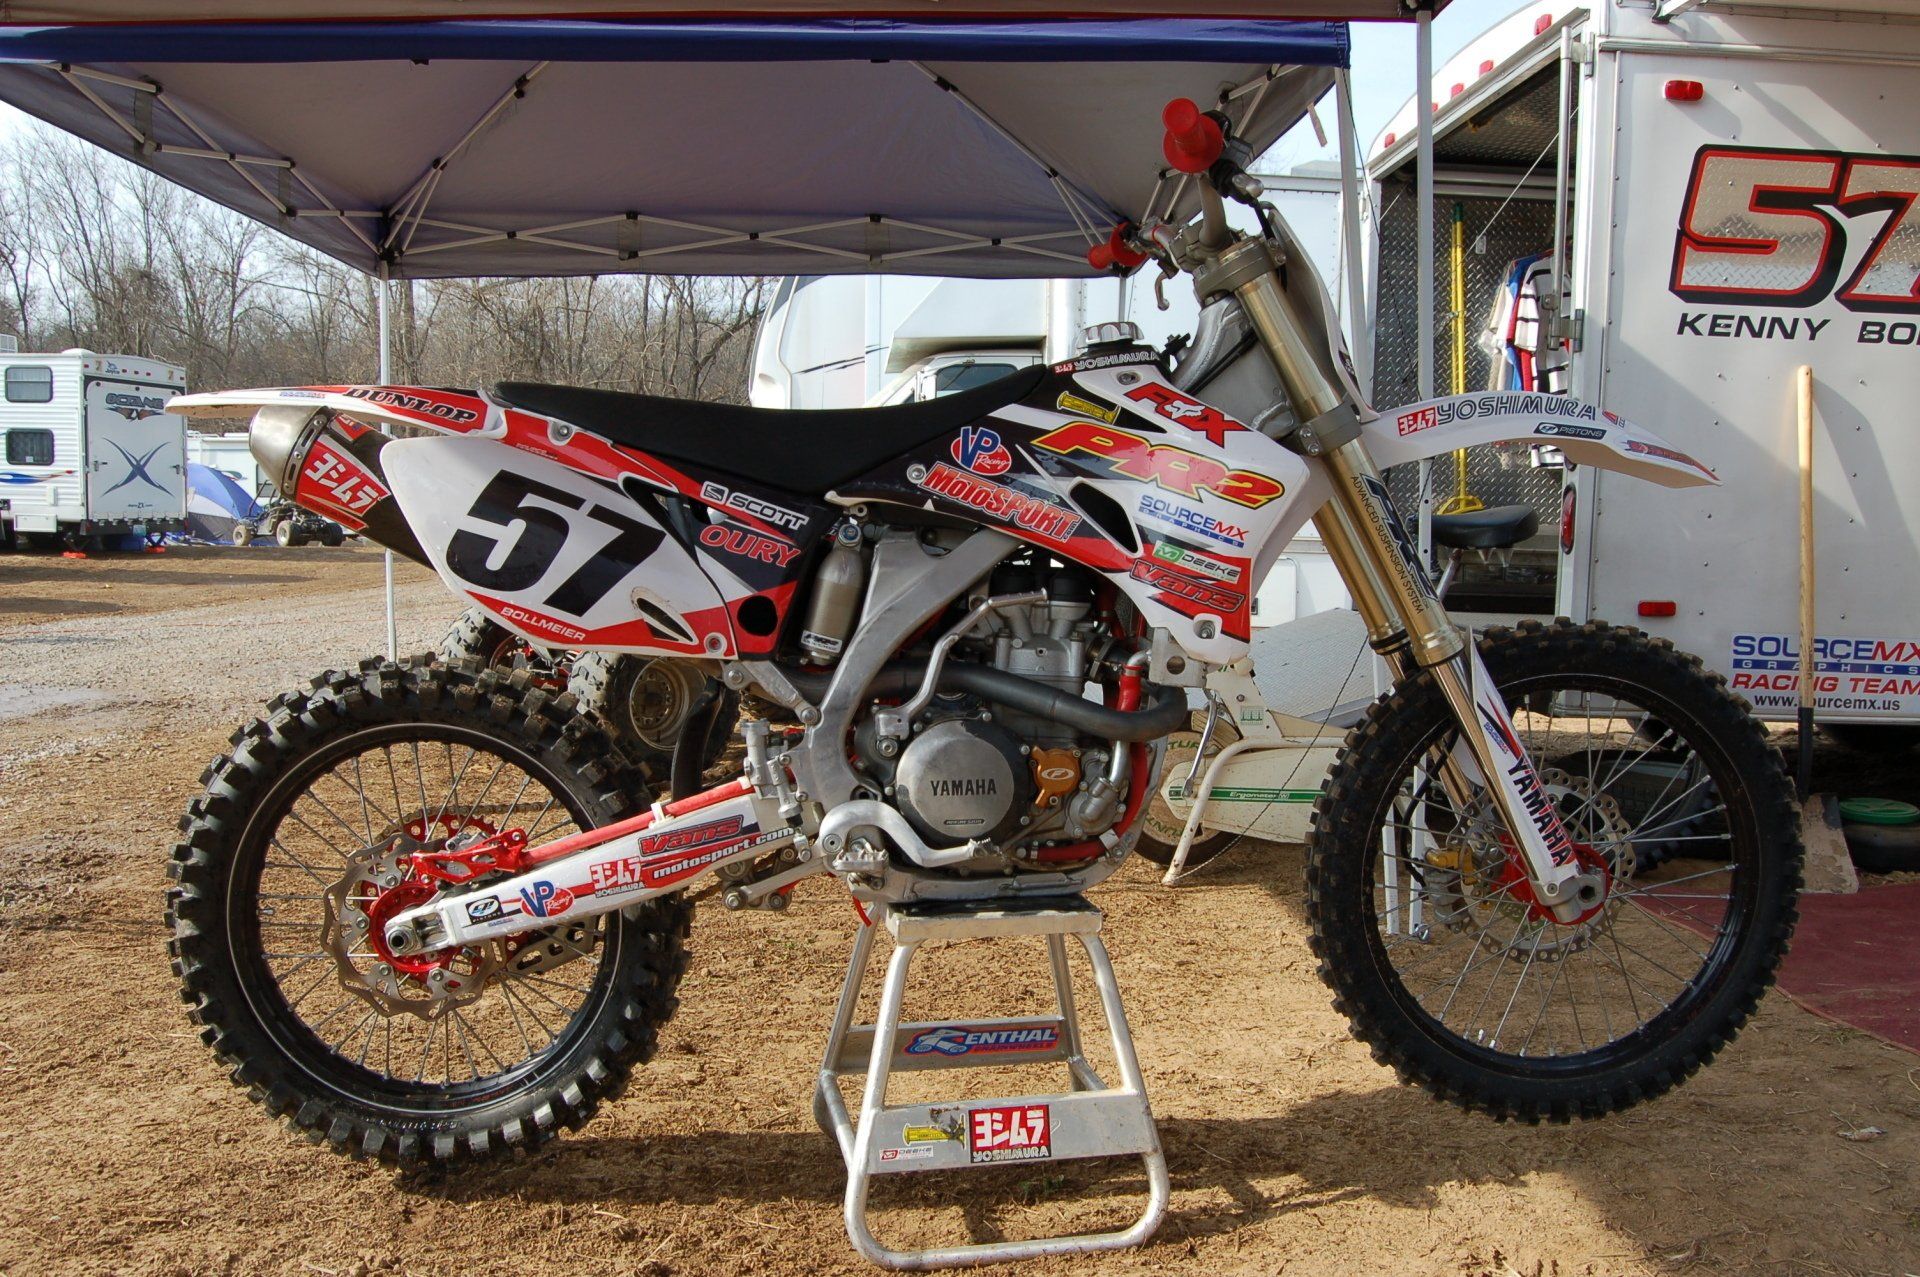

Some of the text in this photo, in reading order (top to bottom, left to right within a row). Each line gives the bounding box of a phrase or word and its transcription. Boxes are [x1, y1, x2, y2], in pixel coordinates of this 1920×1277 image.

[1677, 313, 1920, 346] KENNY BO
[1074, 351, 1160, 371] YOSHIMURA
[343, 388, 478, 424] DUNLOP
[1437, 395, 1596, 425] YOSHIMURA
[959, 426, 1001, 470] VP
[1560, 426, 1603, 438] PISTONS
[1031, 421, 1285, 510] PR2
[727, 492, 809, 530] SCOTT
[1140, 495, 1249, 541] SOURCEMX
[446, 469, 667, 617] 57
[700, 525, 801, 568] OURY
[1350, 475, 1425, 616] ADVANCED SUSPENSION SYSTEM
[1182, 554, 1240, 578] DEEKE
[500, 606, 586, 641] BOLLMEIER
[1731, 673, 1920, 696] RACIG TEAM
[930, 778, 997, 796] YAMAHA
[1508, 755, 1573, 868] YAMAHA
[653, 827, 794, 879] motosport.com
[520, 880, 555, 918] VP
[972, 1145, 1050, 1162] YOSHIMURA
